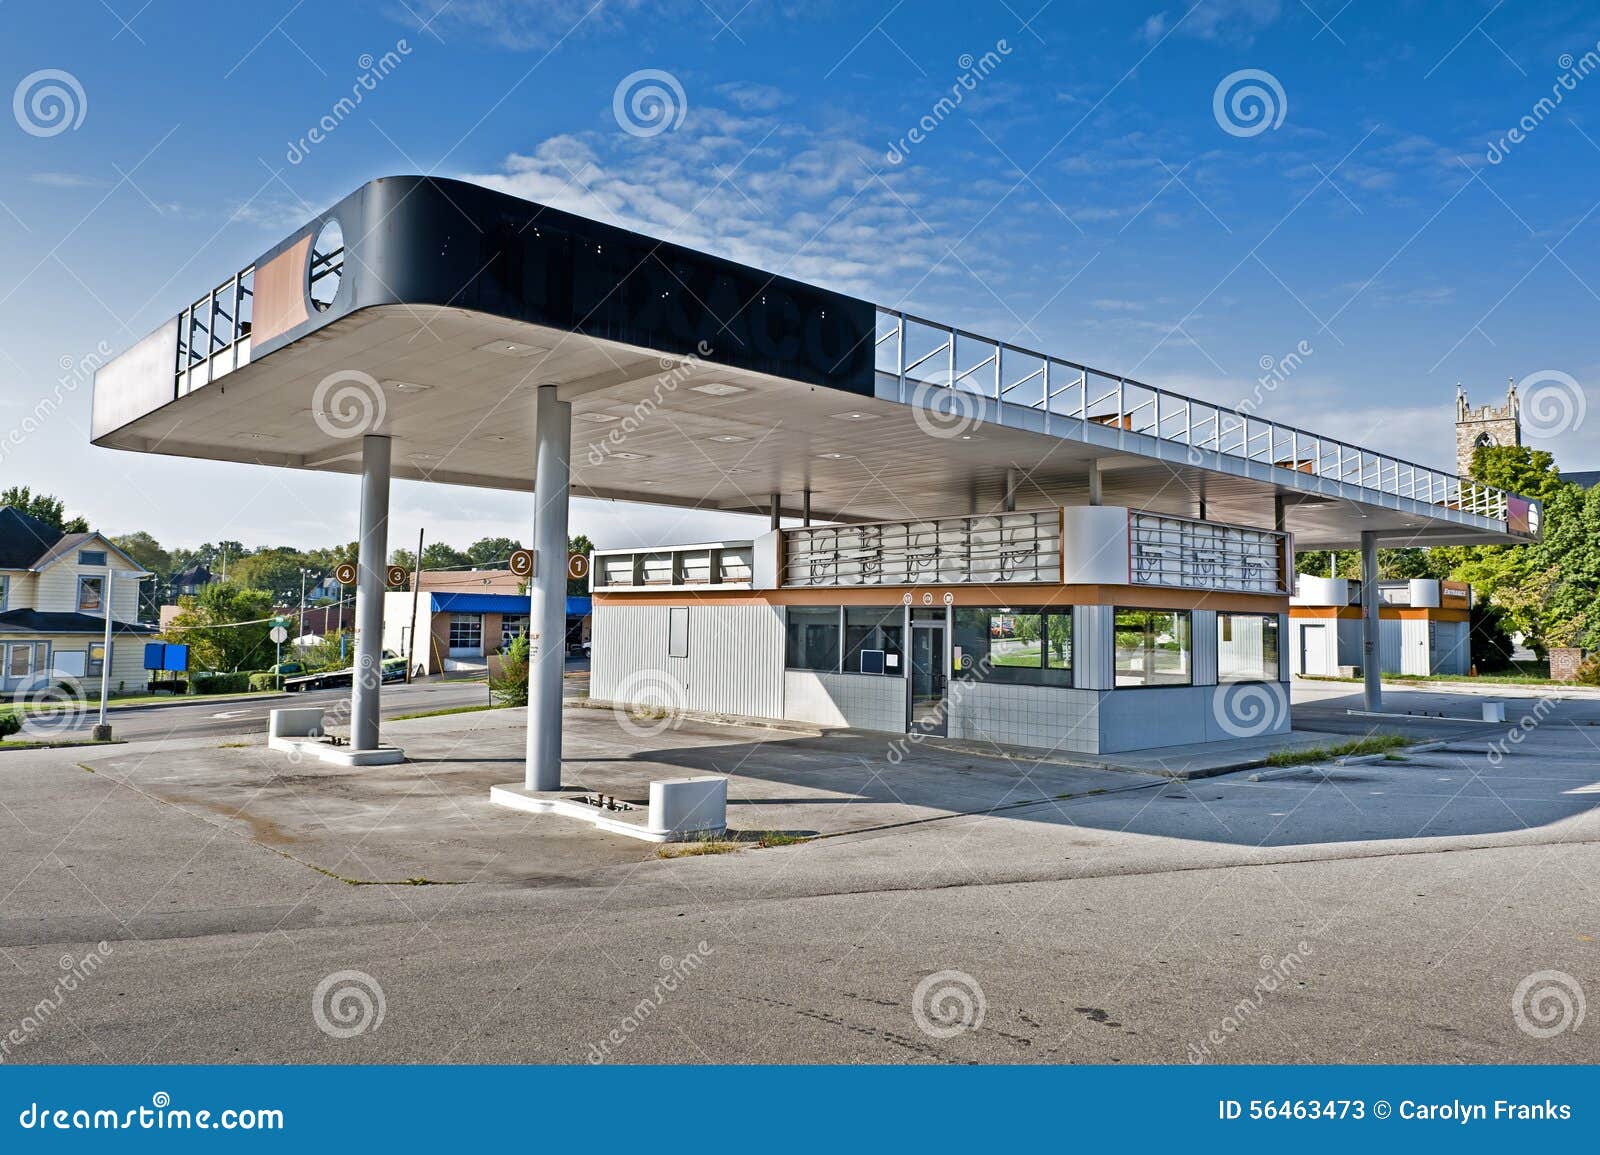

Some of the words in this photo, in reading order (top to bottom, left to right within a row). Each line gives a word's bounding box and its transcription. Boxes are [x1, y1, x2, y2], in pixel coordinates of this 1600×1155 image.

[516, 556, 526, 569] 2
[575, 560, 582, 572] 1
[342, 569, 351, 579] 4
[393, 571, 402, 581] 3
